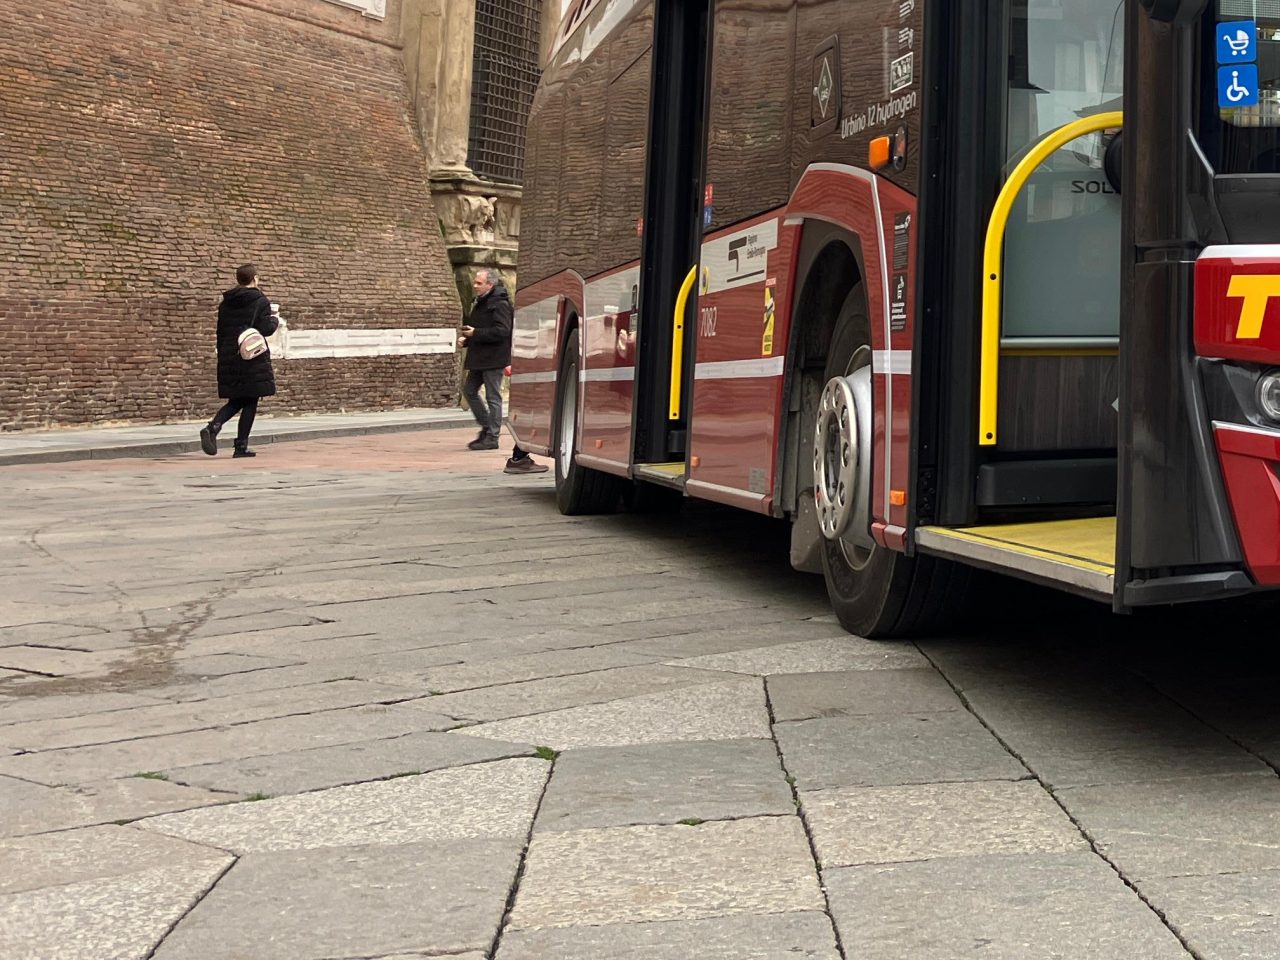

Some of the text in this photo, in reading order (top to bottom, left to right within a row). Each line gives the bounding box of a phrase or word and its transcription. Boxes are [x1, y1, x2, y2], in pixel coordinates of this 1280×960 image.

[841, 91, 917, 139] Urbino 12 hydrogen
[1071, 180, 1115, 194] SOL
[700, 306, 718, 338] 7082
